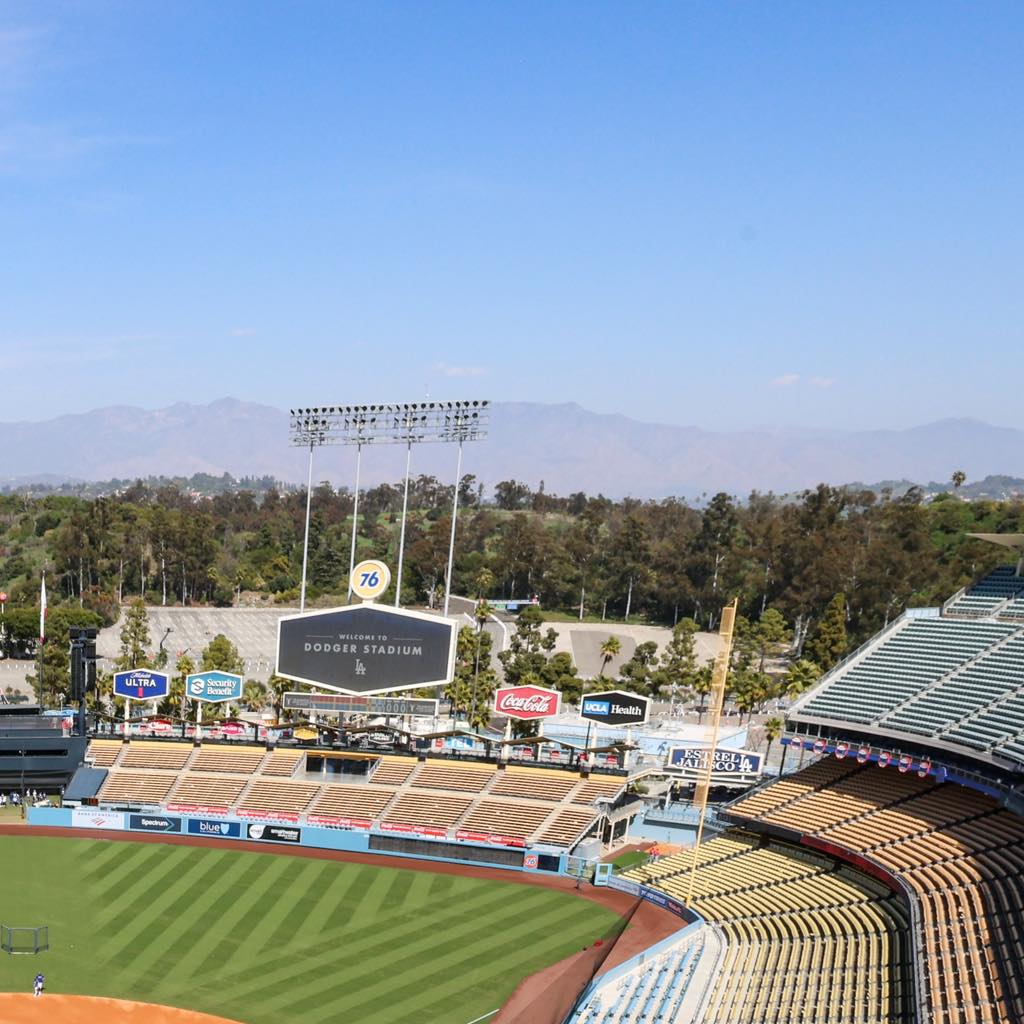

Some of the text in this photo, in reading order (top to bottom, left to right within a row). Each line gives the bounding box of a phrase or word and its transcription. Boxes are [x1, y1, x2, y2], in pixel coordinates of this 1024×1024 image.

[360, 572, 378, 587] 76
[304, 643, 422, 655] DODGER STADIUM
[126, 678, 156, 687] ULTRA
[207, 679, 236, 688] Security
[207, 687, 232, 696] Benefit
[585, 703, 642, 716] UCLA Health
[676, 758, 736, 771] JALISCO
[142, 819, 168, 827] Spectrum
[200, 822, 220, 831] blue
